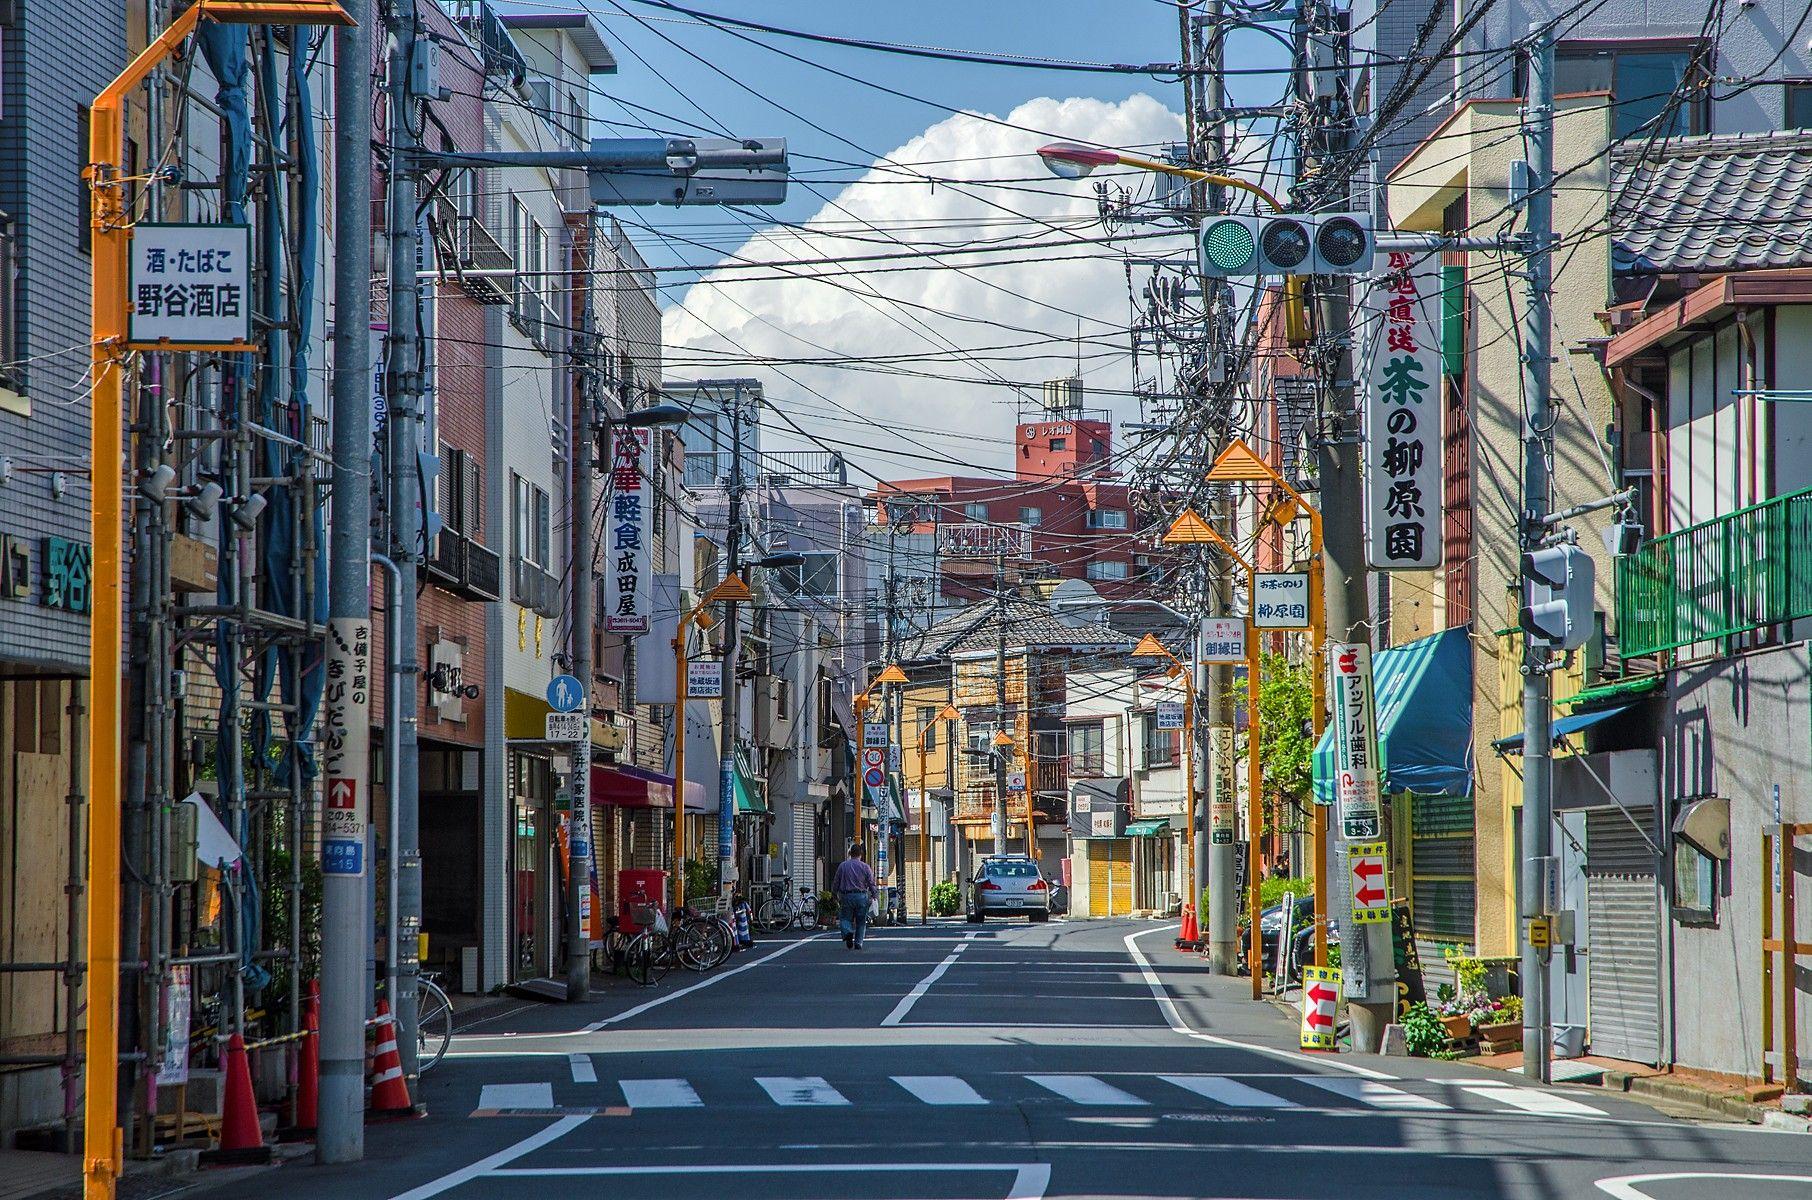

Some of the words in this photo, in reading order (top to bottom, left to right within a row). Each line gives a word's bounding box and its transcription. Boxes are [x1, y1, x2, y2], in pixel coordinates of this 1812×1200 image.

[147, 248, 232, 274] 酒・たばこ
[138, 283, 240, 317] 野谷酒店
[48, 535, 92, 614] 野谷
[1260, 579, 1303, 589] お茶とのり
[1258, 603, 1304, 618] 柳原園
[1205, 642, 1241, 655] 御縁日
[352, 626, 368, 704] 吉備子屋の
[690, 686, 720, 695] 商店街で
[326, 658, 347, 775] きびだんご
[1347, 674, 1368, 770] アップル歯科
[869, 752, 881, 761] 30
[327, 811, 356, 821] この先
[1350, 846, 1383, 855] 売物件
[1306, 969, 1341, 980] 売物件
